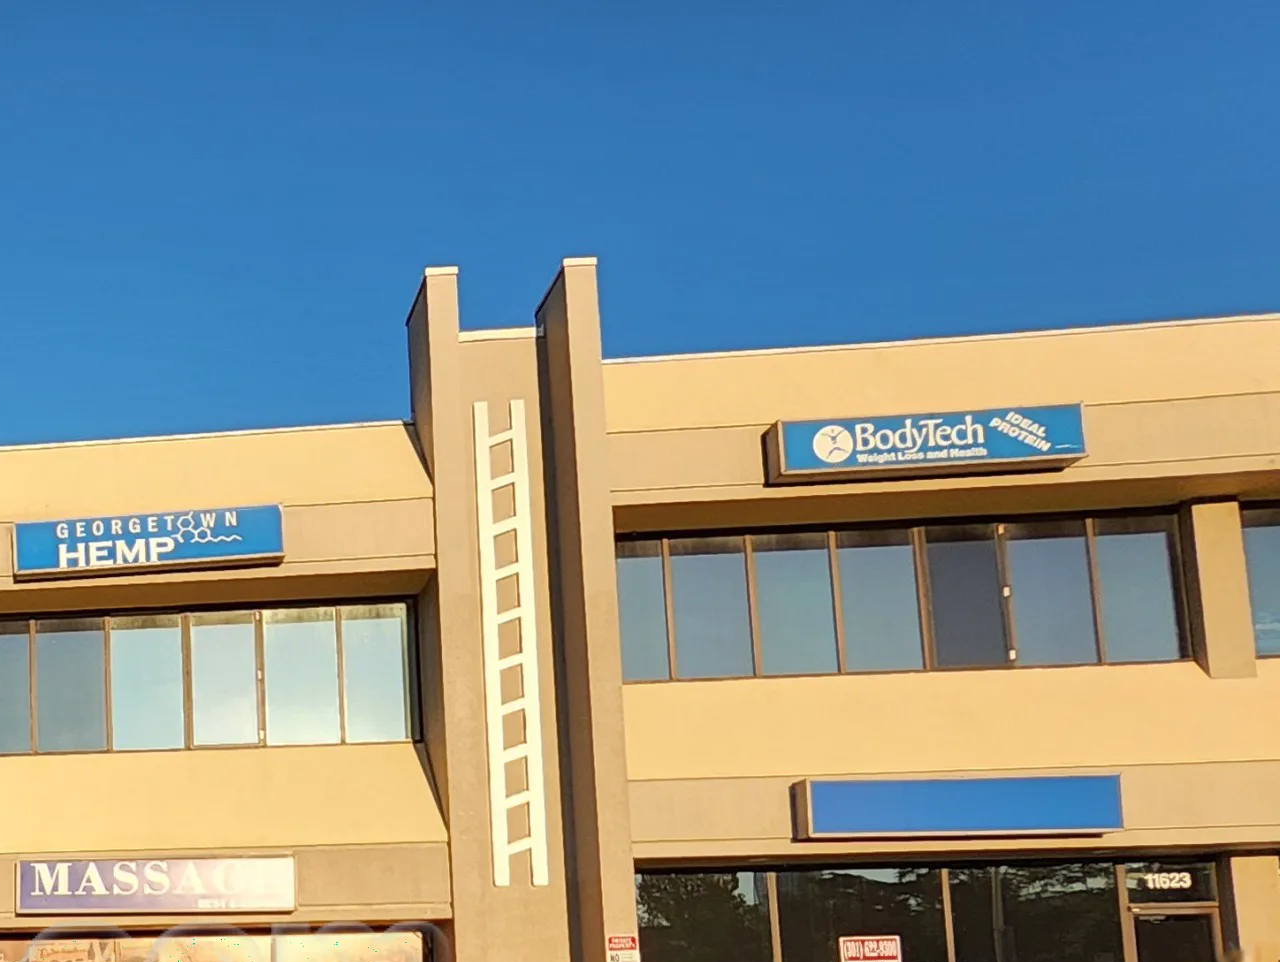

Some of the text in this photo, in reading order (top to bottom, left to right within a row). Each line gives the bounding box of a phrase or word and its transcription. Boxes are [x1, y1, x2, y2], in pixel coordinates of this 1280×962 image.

[855, 415, 985, 453] BodyTech
[987, 417, 1053, 452] PROTEIN
[1004, 410, 1047, 438] IDEAL
[897, 451, 924, 460] Loss
[926, 449, 948, 459] and
[57, 536, 175, 570] HEMP
[1144, 872, 1193, 890] 11623
